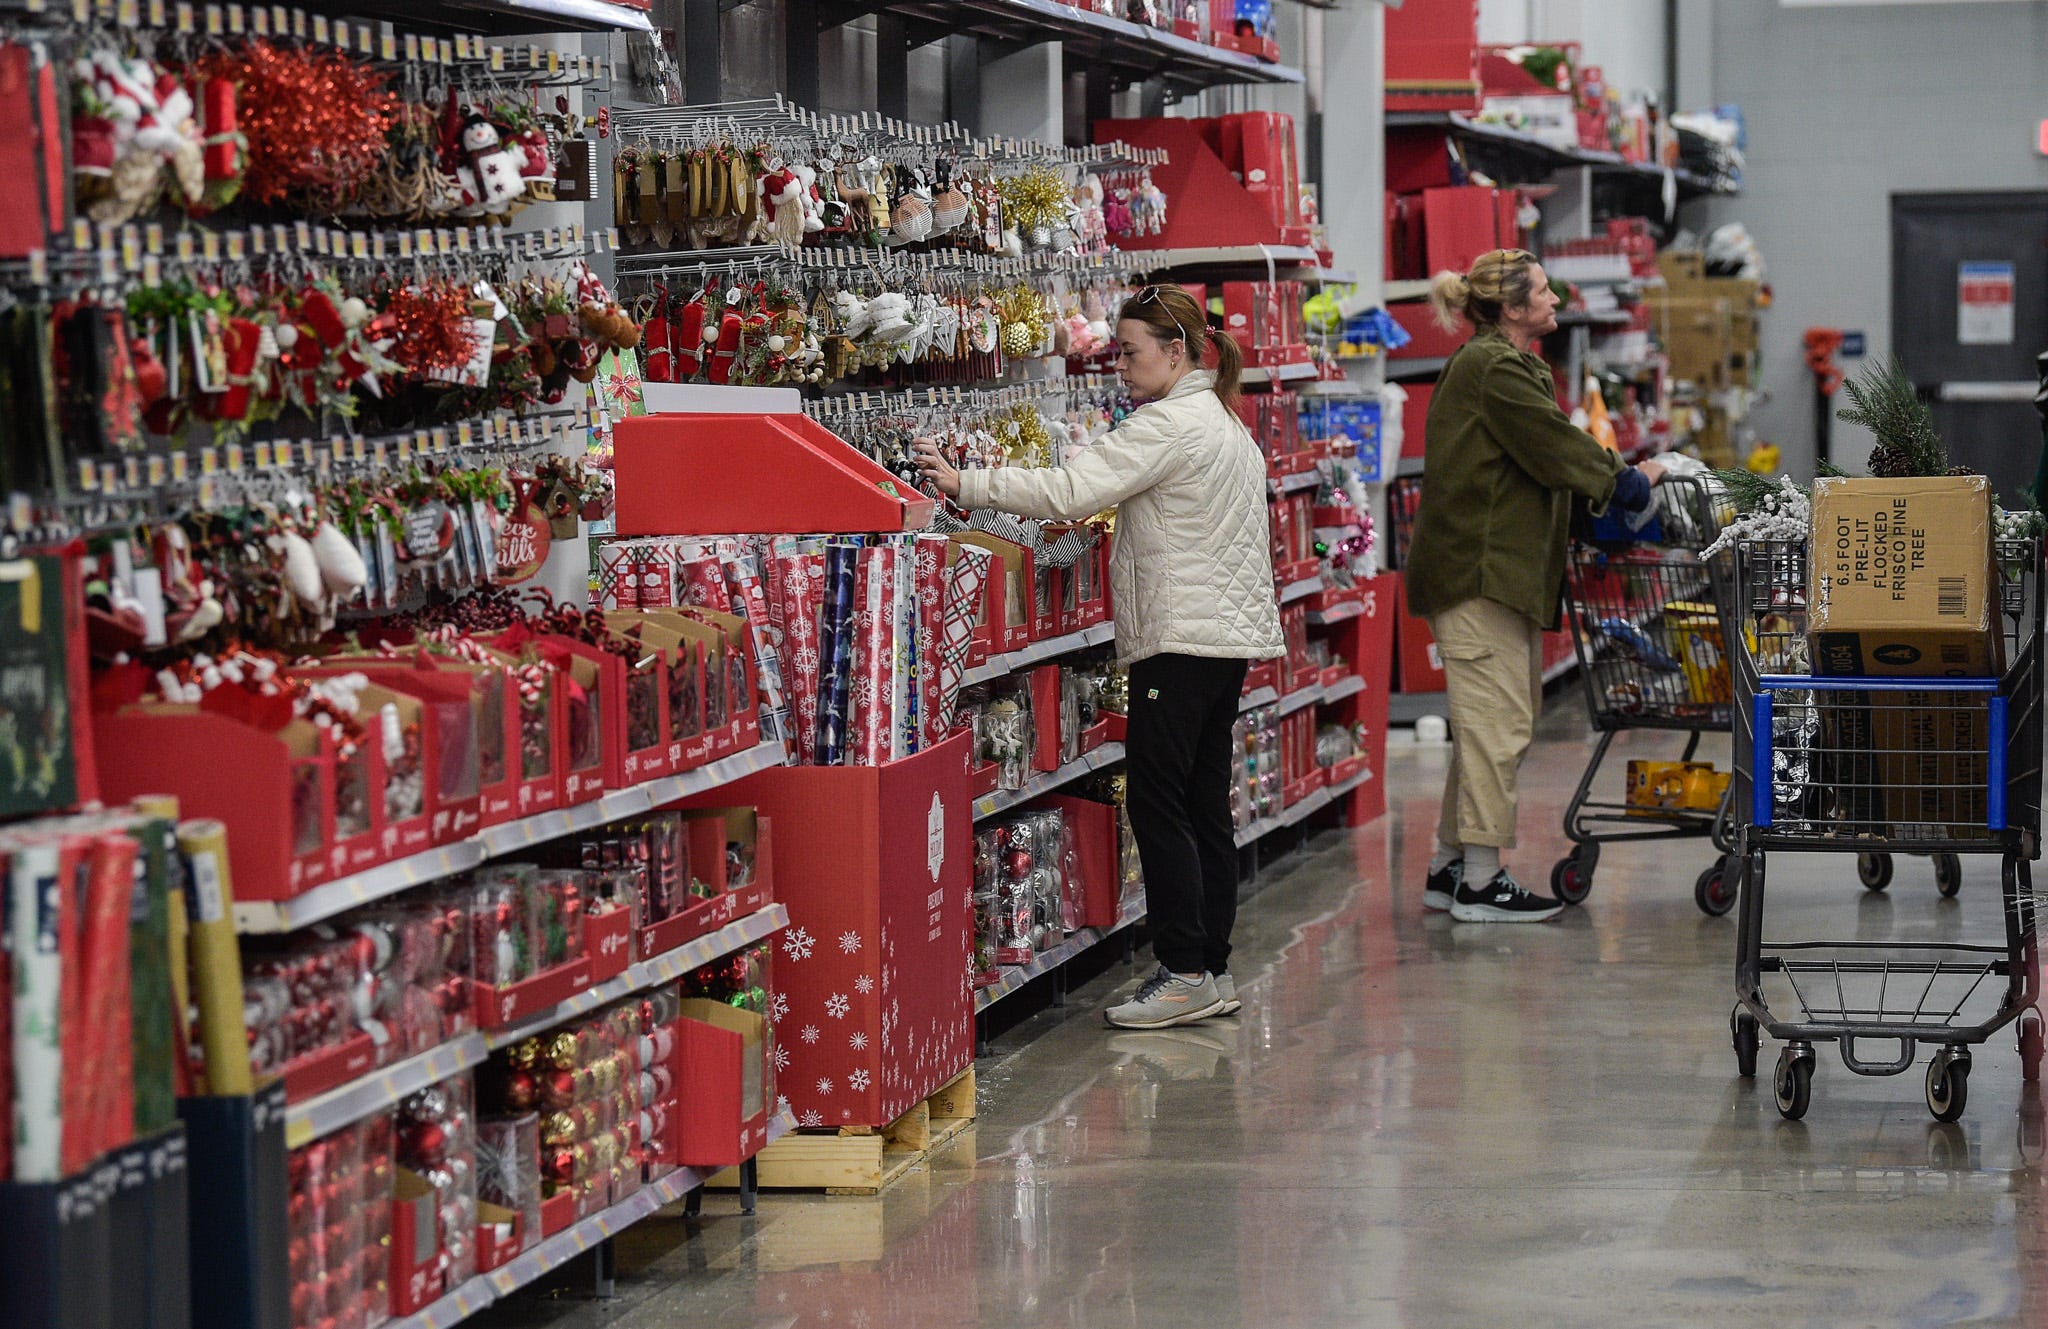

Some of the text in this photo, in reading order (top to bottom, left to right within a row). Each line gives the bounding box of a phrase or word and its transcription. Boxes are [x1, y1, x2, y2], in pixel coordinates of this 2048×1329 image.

[1836, 515, 1851, 586] 6.5 FOOT
[1855, 518, 1869, 582] PRE-LIT
[1873, 511, 1888, 589] FLOCKED
[1892, 498, 1907, 601] FRISCO PINE
[1911, 528, 1925, 572] TREE
